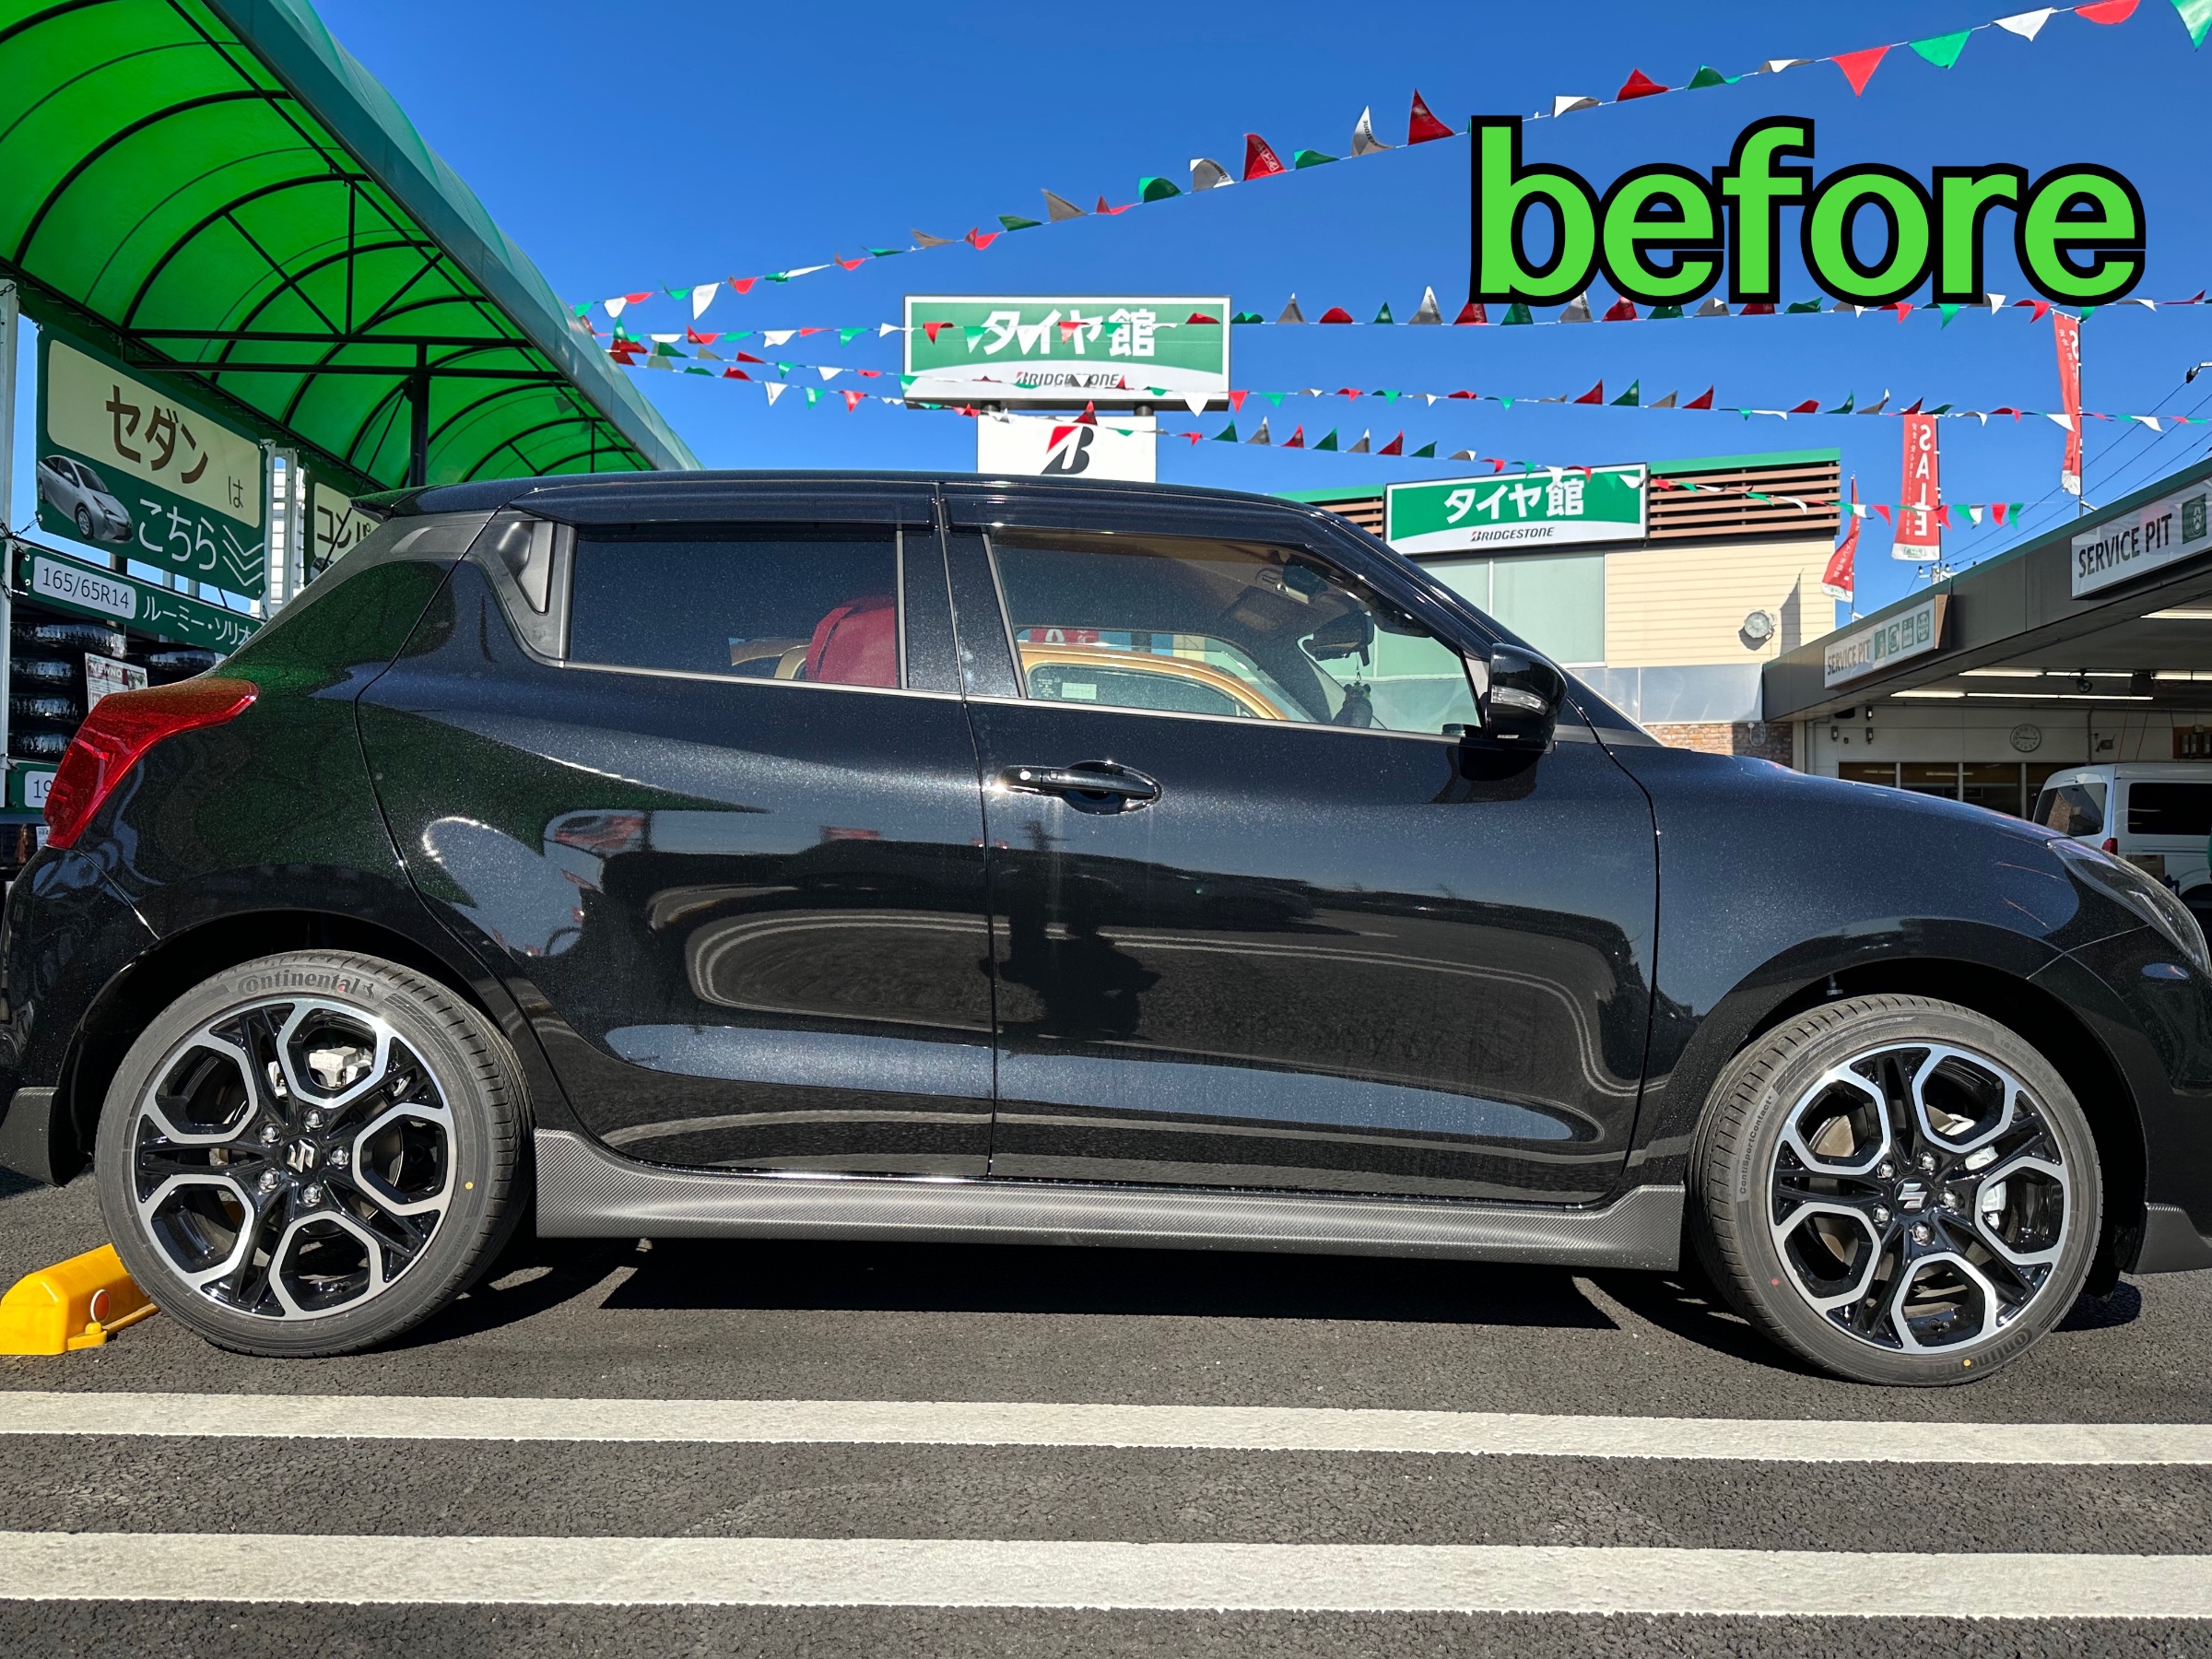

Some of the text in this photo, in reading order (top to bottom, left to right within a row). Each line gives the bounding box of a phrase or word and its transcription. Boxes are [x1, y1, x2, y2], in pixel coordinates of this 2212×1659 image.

[981, 308, 1156, 357] タイヤ館
[1015, 371, 1120, 387] BRIDGEONE
[106, 384, 244, 508] セダン は
[1444, 477, 1584, 524] タイヤ館
[139, 498, 218, 571] こちら
[1470, 526, 1555, 542] BRIDGESTONE
[2078, 513, 2172, 579] SERVICE PIT
[42, 566, 130, 609] 165/65R14
[1827, 639, 1870, 676] SERVICE PIT
[238, 970, 360, 997] Continental
